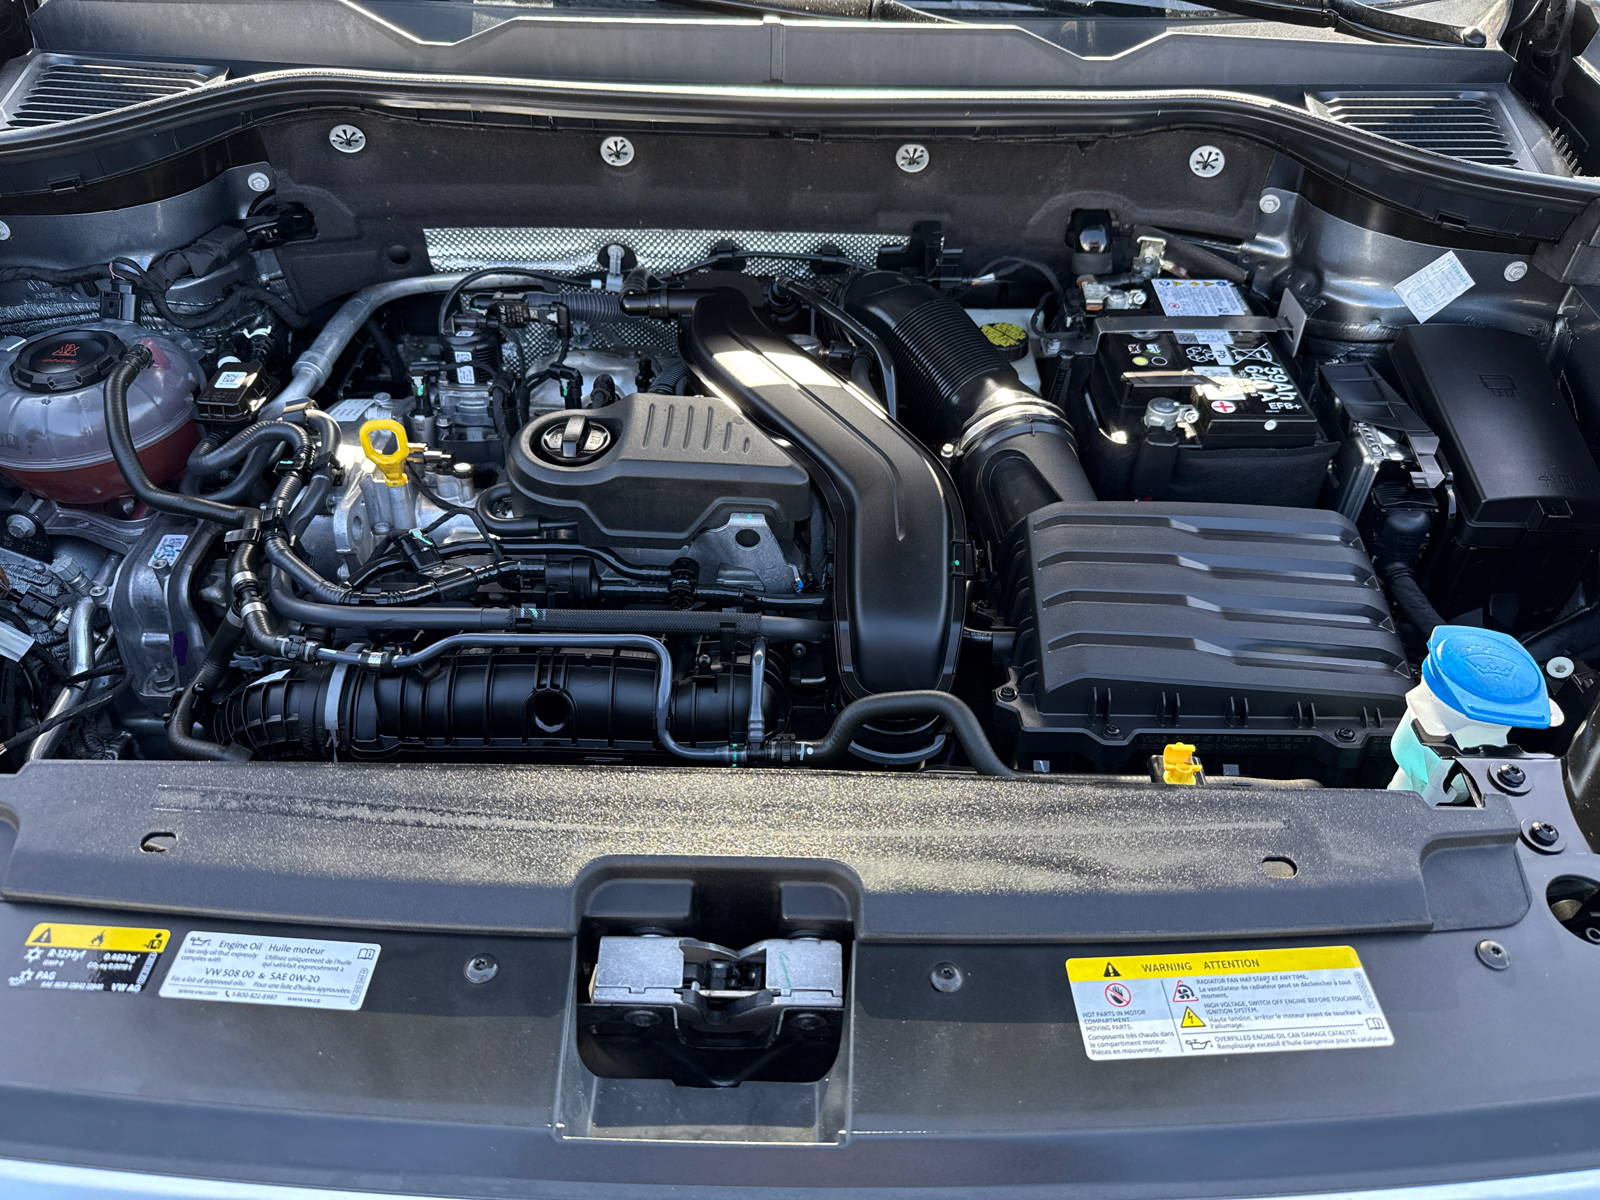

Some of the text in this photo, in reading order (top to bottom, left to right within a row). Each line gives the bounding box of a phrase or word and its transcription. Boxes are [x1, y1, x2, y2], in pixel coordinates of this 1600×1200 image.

[1215, 350, 1227, 359] Pb
[1264, 366, 1298, 400] 59Ah
[1268, 402, 1302, 410] EFB+
[219, 940, 325, 955] Engine Oil Huile moteur
[47, 948, 87, 962] R-1234yf
[288, 956, 324, 965] uniquement
[1141, 958, 1260, 972] WARNING ATTENTION
[298, 964, 339, 973] expressément
[35, 970, 57, 980] PAG
[205, 967, 222, 976] VW
[222, 968, 240, 977] 508
[270, 972, 288, 981] SAE
[289, 974, 320, 983] 0W-20
[111, 982, 127, 992] VW
[126, 984, 141, 994] AG
[232, 990, 277, 1000] 1-800-822-8987
[1088, 1033, 1125, 1041] Composants
[1097, 1040, 1141, 1048] compartiment
